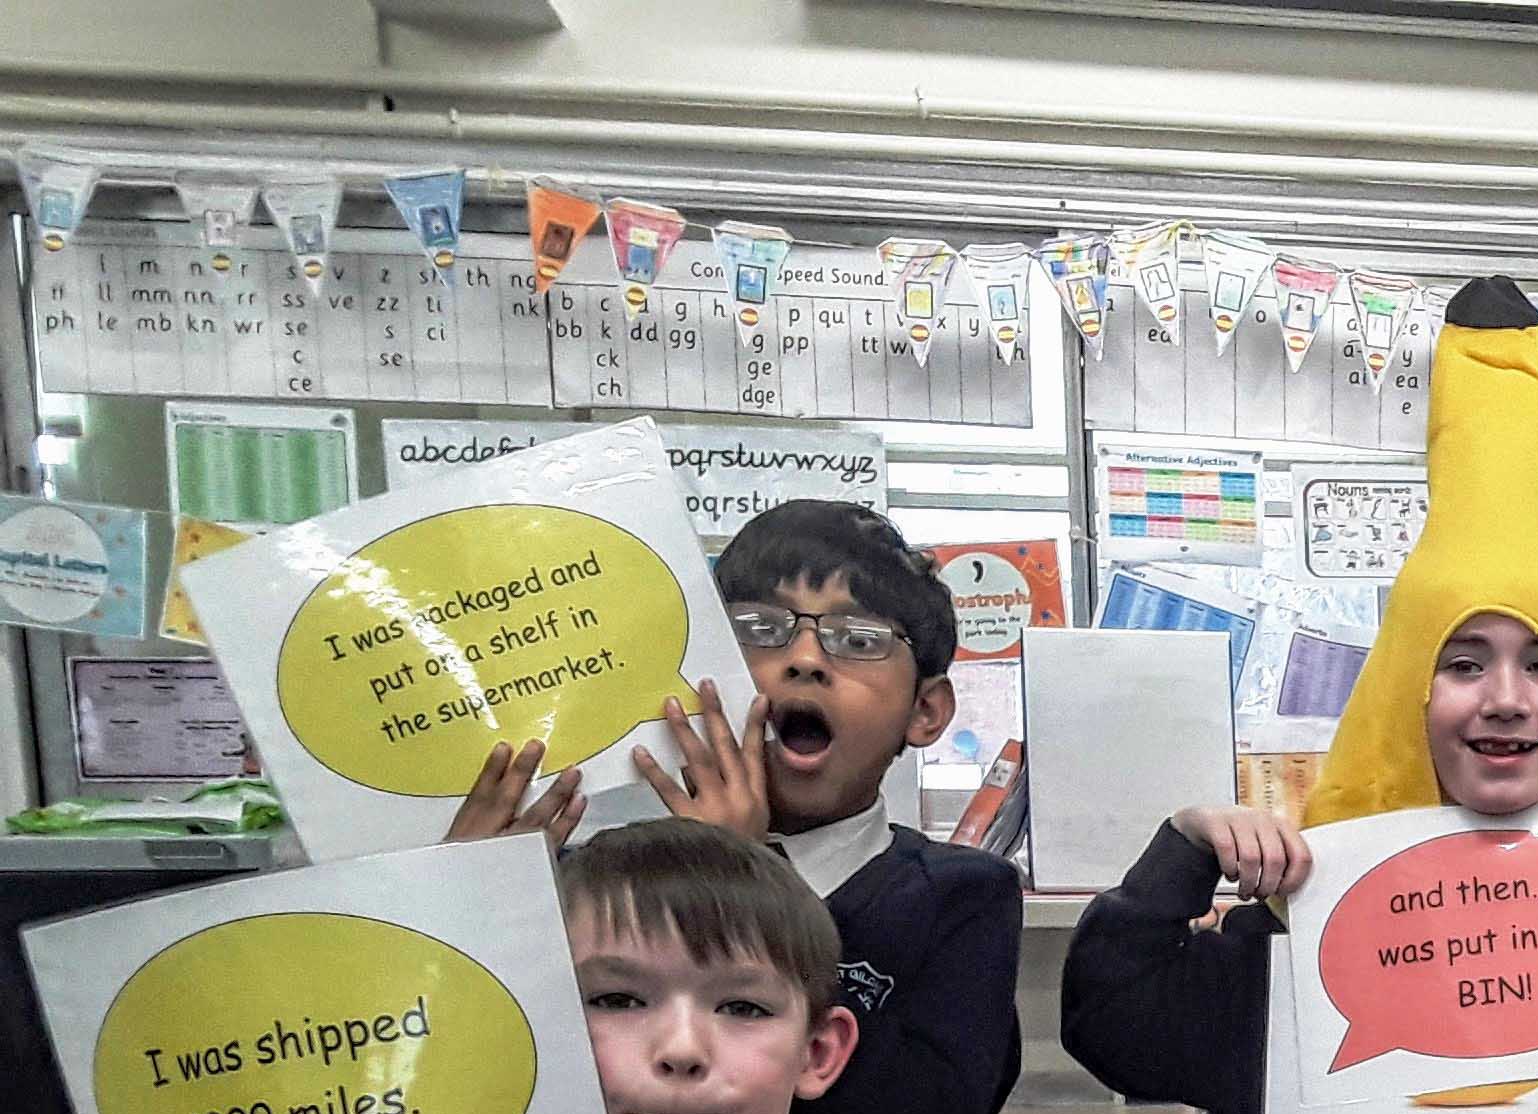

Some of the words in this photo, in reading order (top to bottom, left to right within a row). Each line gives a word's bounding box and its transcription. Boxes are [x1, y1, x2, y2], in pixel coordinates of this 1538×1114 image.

[139, 258, 160, 274] m
[190, 261, 203, 275] n
[241, 263, 249, 278] r
[287, 265, 298, 280] s
[333, 266, 344, 281] v
[466, 265, 491, 288] th
[831, 268, 888, 286] Sound
[131, 288, 172, 302] mm
[184, 290, 214, 303] nn
[237, 292, 257, 305] rr
[282, 293, 305, 308] ss
[328, 295, 354, 310] ve
[376, 297, 400, 312] zz
[513, 298, 540, 317] nk
[562, 290, 574, 311] b
[600, 298, 610, 312] c
[675, 301, 687, 321] g
[713, 298, 726, 318] h
[789, 307, 800, 327] p
[818, 310, 846, 328] qu
[865, 309, 873, 326] t
[937, 316, 946, 329] x
[969, 318, 980, 337] y
[1255, 309, 1266, 323] o
[46, 310, 74, 334] ph
[137, 312, 173, 332] mb
[186, 313, 217, 333] kn
[234, 320, 264, 335] wr
[284, 321, 309, 336] se
[384, 325, 395, 339] s
[426, 322, 447, 341] ci
[556, 318, 582, 338] bb
[601, 320, 612, 340] k
[630, 322, 658, 342] dd
[669, 329, 696, 350] gg
[752, 334, 764, 354] g
[783, 336, 809, 355] pp
[862, 336, 879, 354] tt
[293, 350, 304, 364] c
[379, 352, 403, 367] se
[1148, 327, 1172, 344] ea
[1402, 350, 1413, 367] y
[596, 348, 620, 368] ck
[747, 360, 772, 381] ge
[289, 377, 313, 392] ce
[597, 377, 622, 397] ch
[742, 384, 776, 409] dge
[1395, 375, 1419, 389] ea
[1402, 401, 1412, 415] e
[1328, 481, 1369, 497] Nouns
[323, 634, 346, 661] I
[351, 620, 404, 651] was
[550, 550, 602, 587] and
[369, 662, 417, 704] put
[465, 644, 484, 663] a
[489, 610, 561, 656] shelf
[568, 606, 599, 630] in
[380, 711, 432, 743] the
[437, 647, 625, 720] supermarket.
[1390, 881, 1446, 915] and
[1379, 938, 1436, 968] was
[1447, 927, 1499, 967] put
[1510, 924, 1538, 952] in
[1457, 973, 1534, 1009] BIN!
[144, 1048, 171, 1089] I
[176, 1040, 244, 1082] was
[256, 994, 432, 1067] shipped
